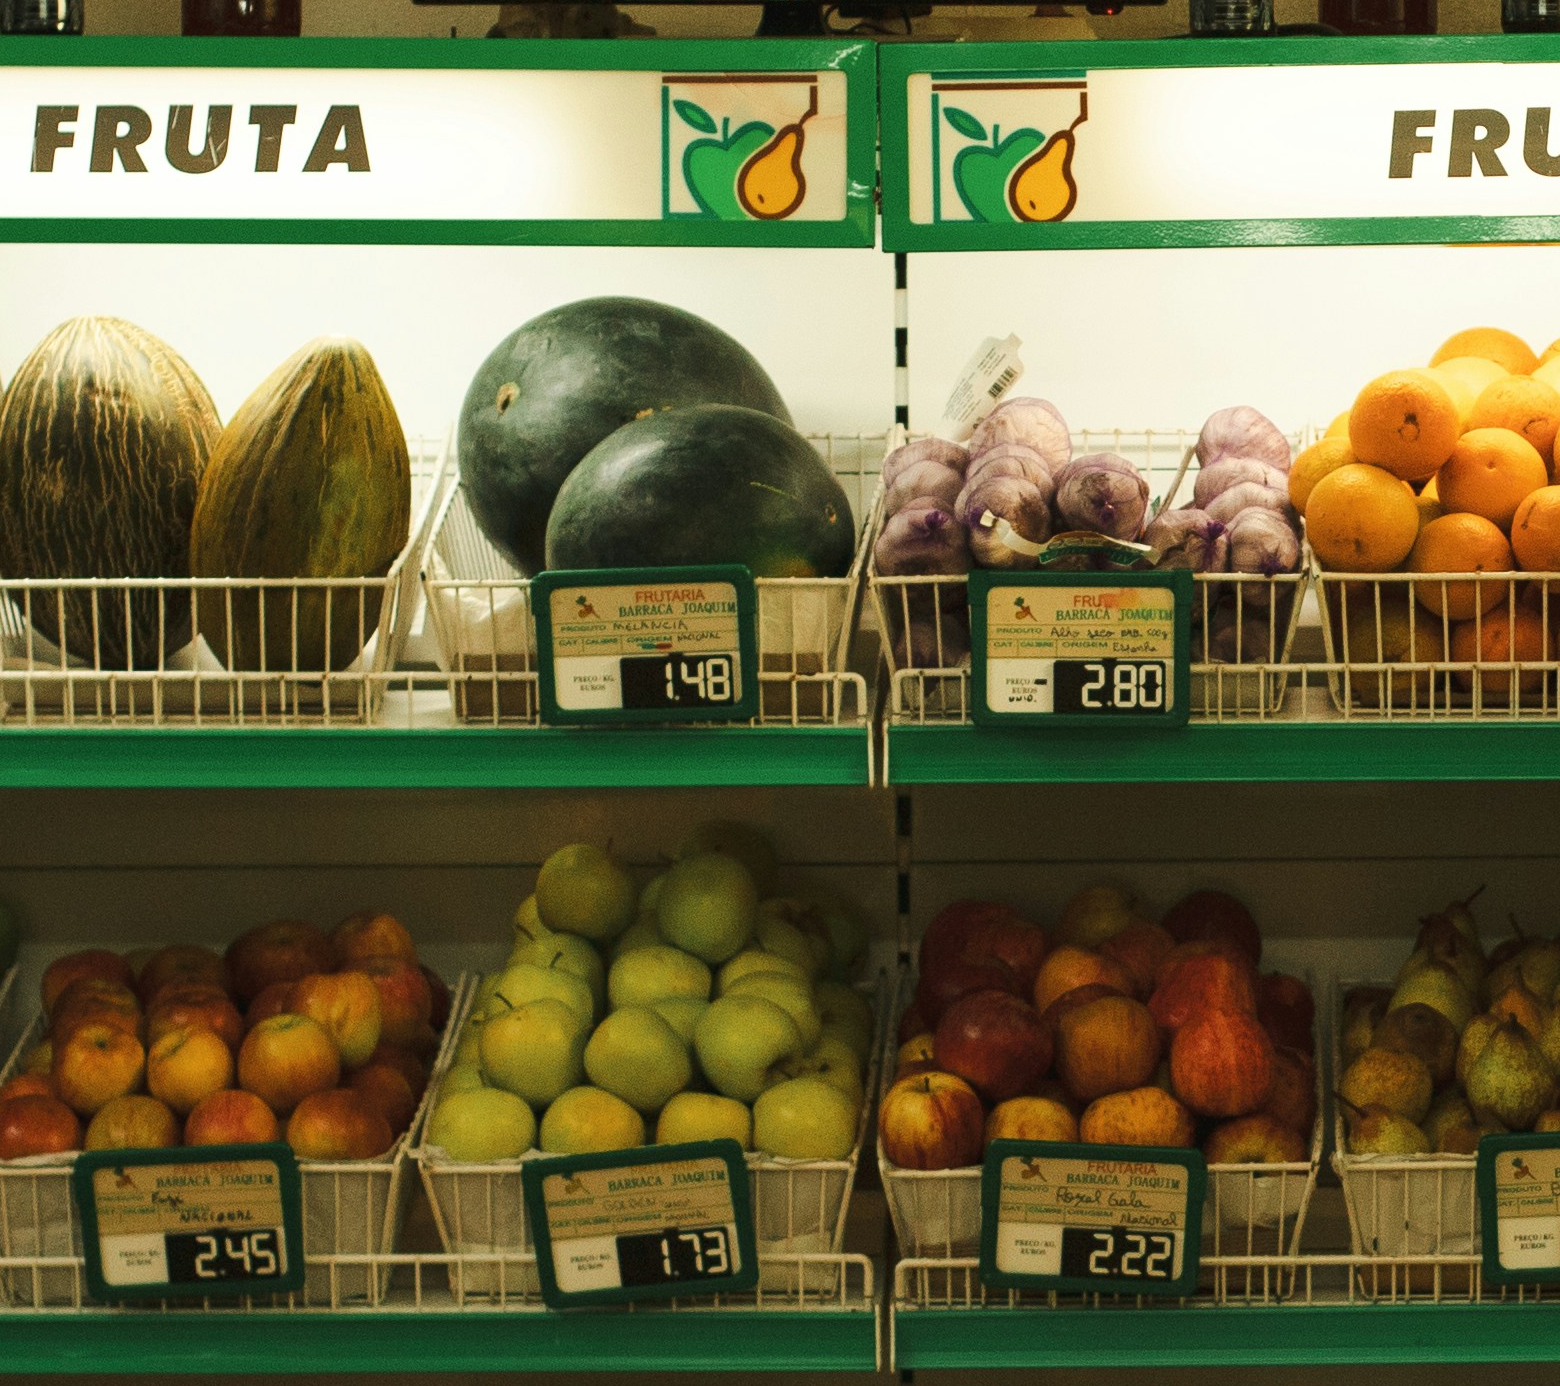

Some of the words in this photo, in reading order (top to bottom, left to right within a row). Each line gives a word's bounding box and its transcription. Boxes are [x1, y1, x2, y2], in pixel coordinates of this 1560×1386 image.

[31, 104, 371, 174] FRUTA
[635, 589, 705, 603] FRUTARIA
[619, 604, 673, 617] BARRACA
[683, 602, 736, 614] JOAQUIM
[1056, 610, 1110, 621] BARRACA
[613, 620, 688, 631] MELANCIA
[1051, 627, 1079, 638] Alho
[1082, 665, 1162, 707] 2.80
[1087, 1163, 1157, 1175] FRUTARIA
[1067, 1173, 1118, 1185] BARRACA
[1108, 1191, 1152, 1208] Gala
[1090, 1234, 1171, 1277] 2.22
